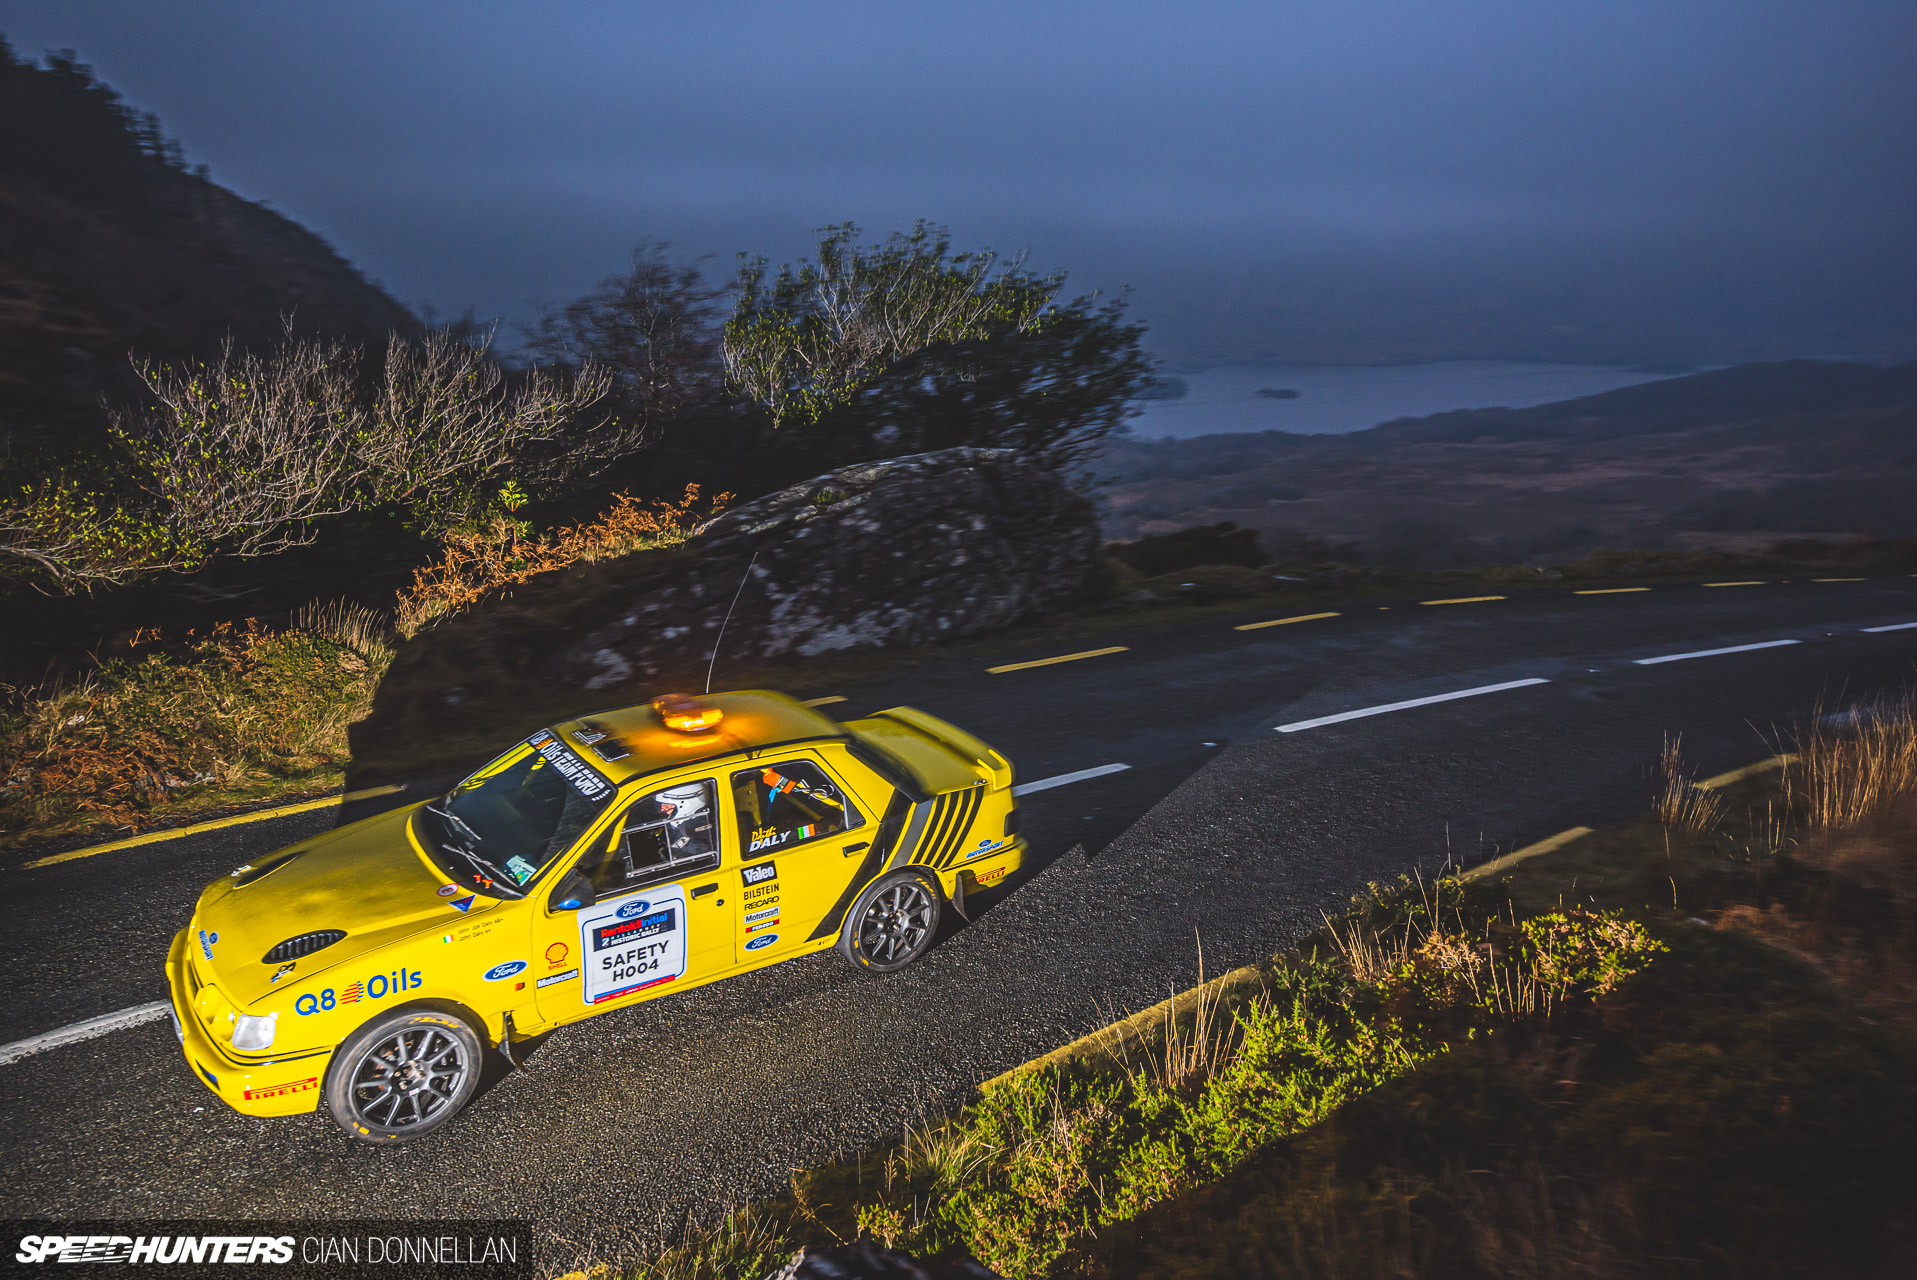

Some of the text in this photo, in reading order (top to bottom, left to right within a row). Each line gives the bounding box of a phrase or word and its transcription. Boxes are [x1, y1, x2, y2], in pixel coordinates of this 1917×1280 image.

[749, 830, 791, 852] DALY
[743, 865, 775, 884] Valeo
[744, 883, 779, 900] BILSTEIN
[622, 902, 644, 917] Ford
[744, 895, 779, 911] RECARO
[745, 908, 779, 923] Motorcraft
[611, 933, 641, 946] HISTORIC
[640, 927, 660, 940] RALLY
[751, 936, 773, 949] Ford
[602, 940, 670, 970] SAFETY
[492, 962, 519, 979] Ford
[548, 962, 568, 971] SHELL
[612, 958, 659, 982] H004
[536, 969, 579, 989] Motorcraft
[294, 967, 423, 1016] Q8 Oils
[243, 1076, 319, 1101] PIRELLI
